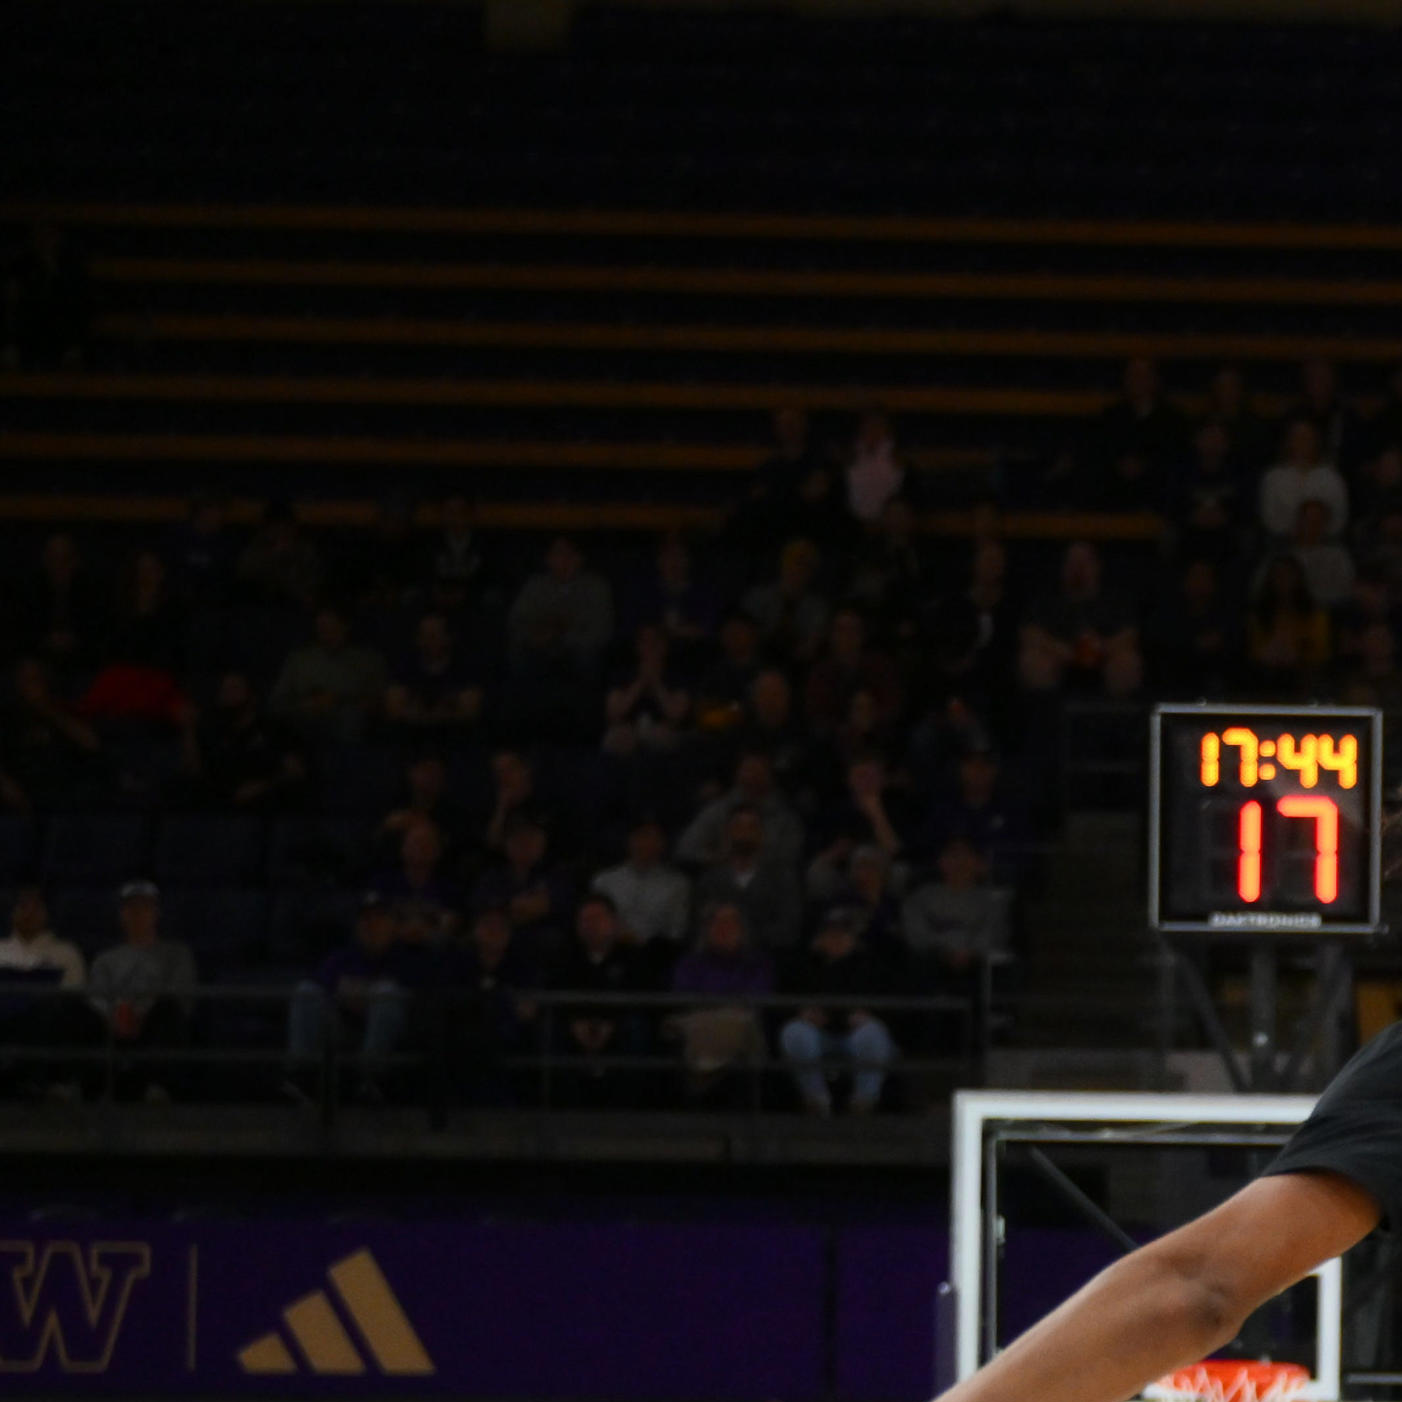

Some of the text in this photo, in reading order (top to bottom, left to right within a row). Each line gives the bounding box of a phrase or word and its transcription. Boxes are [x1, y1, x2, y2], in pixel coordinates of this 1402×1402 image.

[1199, 726, 1359, 790] 17:44
[1236, 794, 1341, 905] 17
[0, 1239, 151, 1373] W
